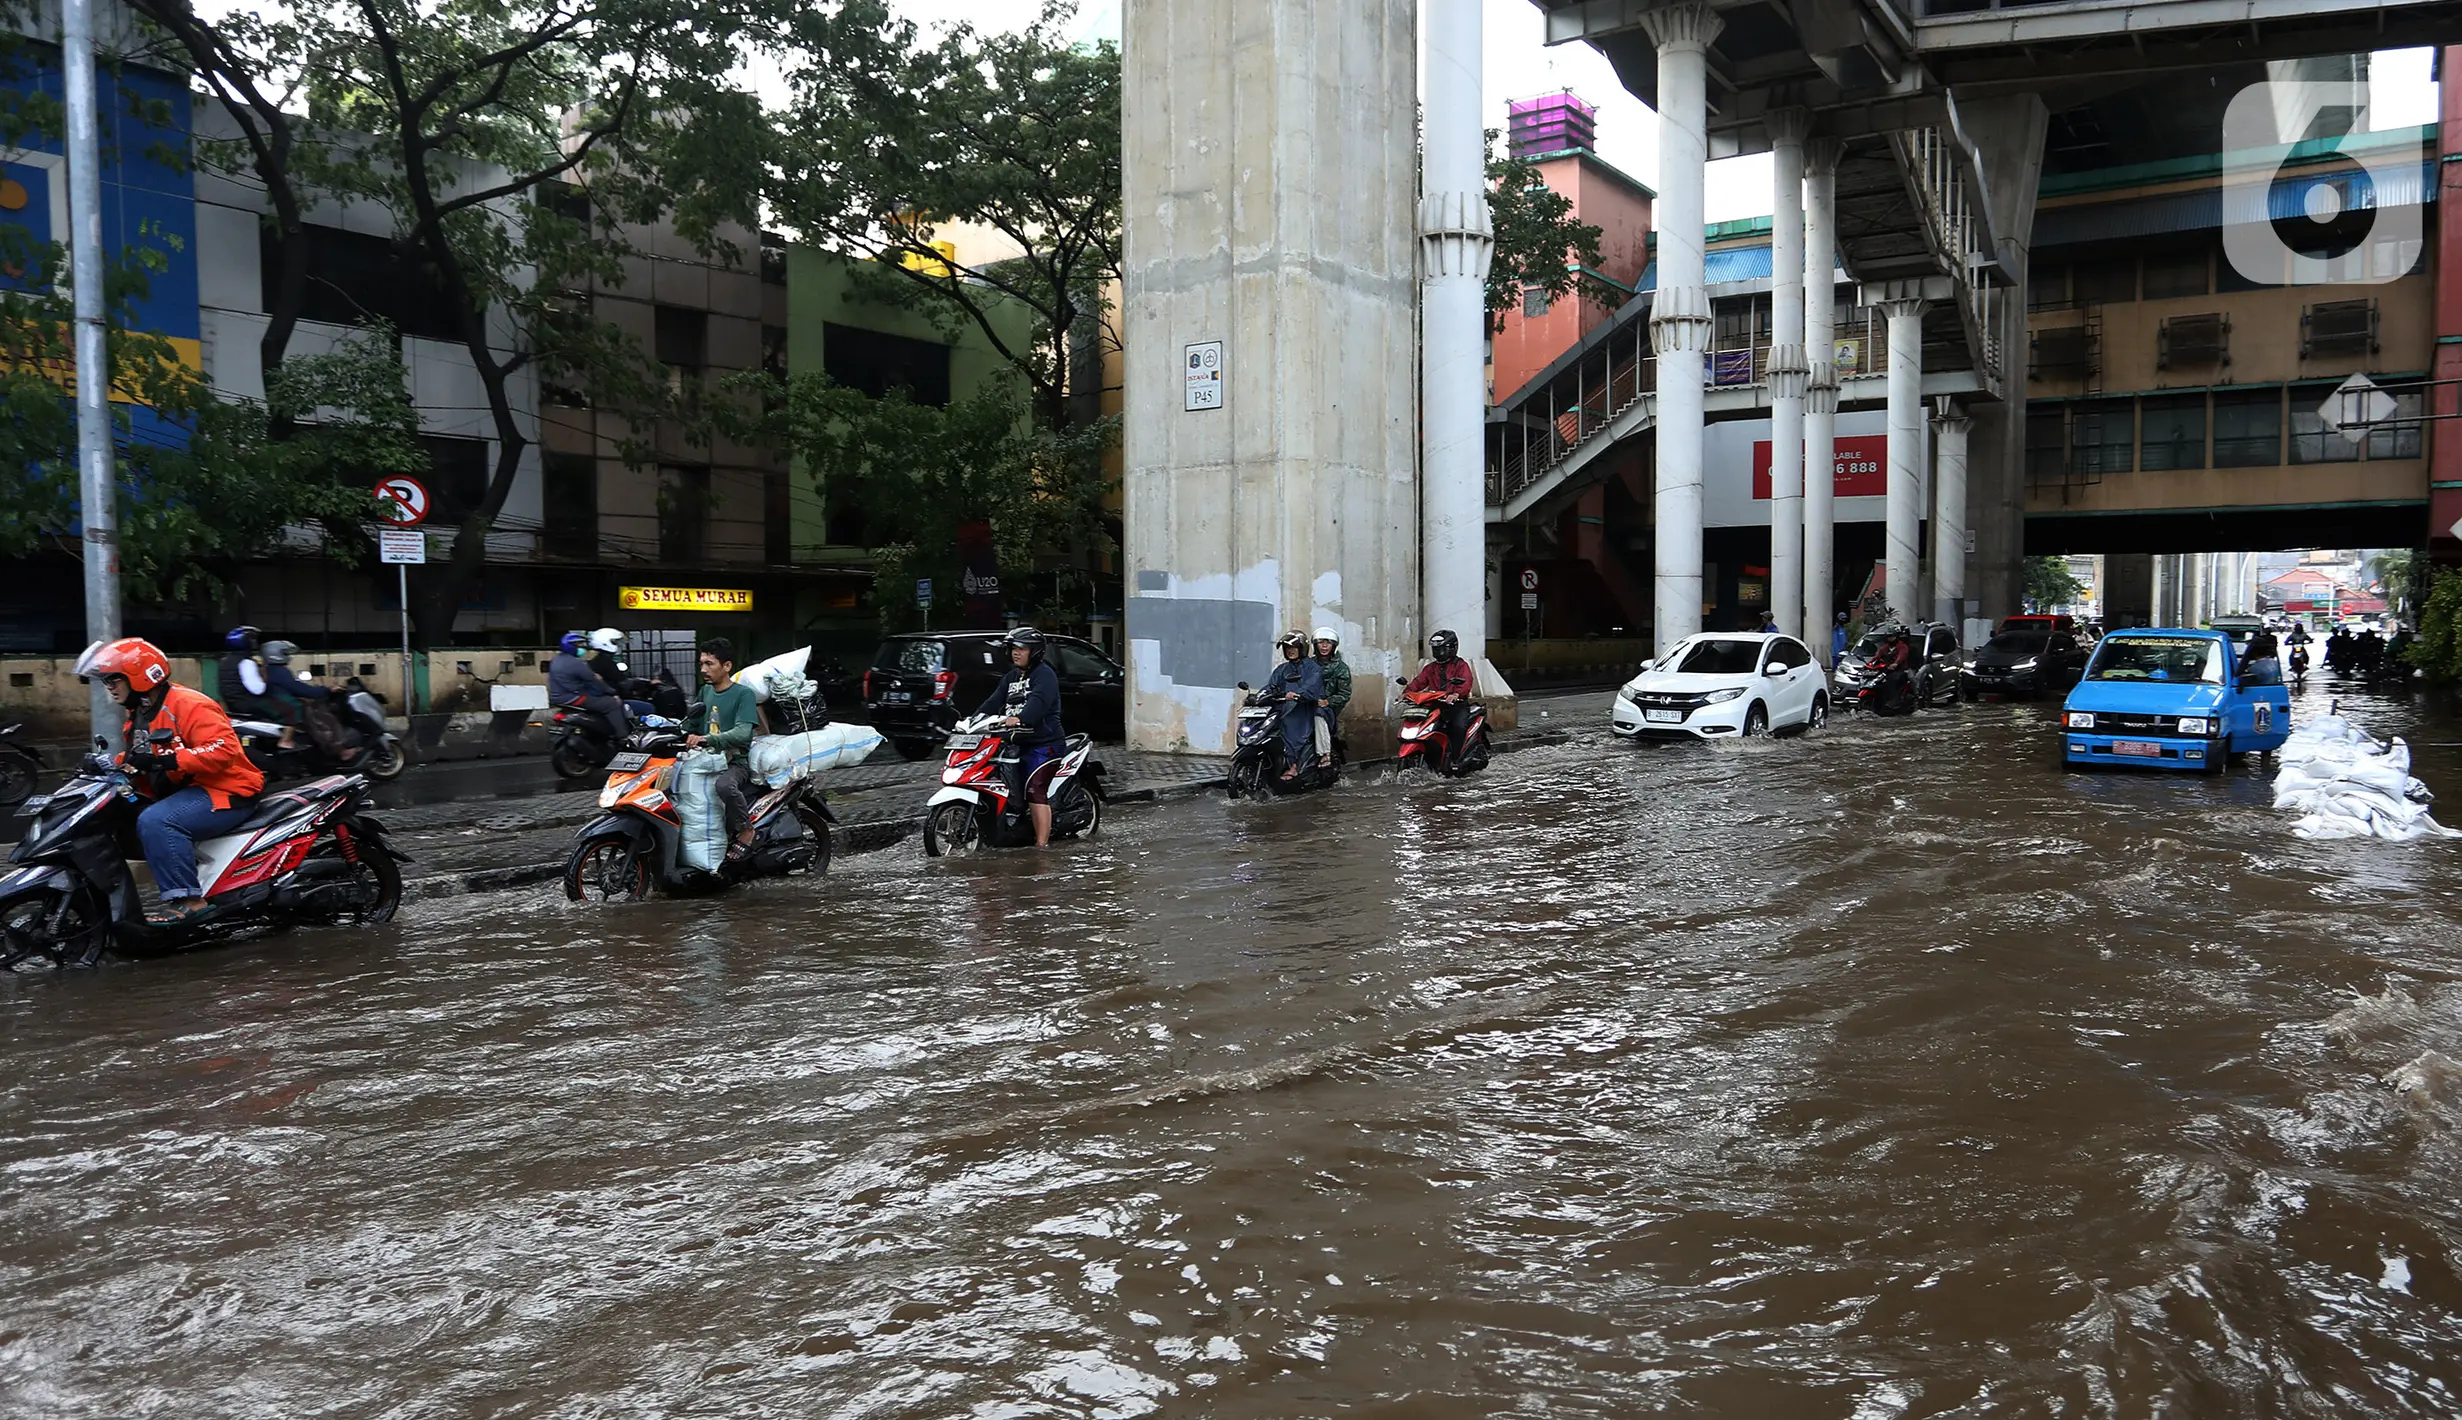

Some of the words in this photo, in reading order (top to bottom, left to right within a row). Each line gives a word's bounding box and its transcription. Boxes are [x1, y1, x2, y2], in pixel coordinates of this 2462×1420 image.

[1194, 391, 1213, 404] P45
[1850, 462, 1877, 474] 888
[643, 589, 692, 603] SEMUA
[696, 591, 747, 604] MURAH
